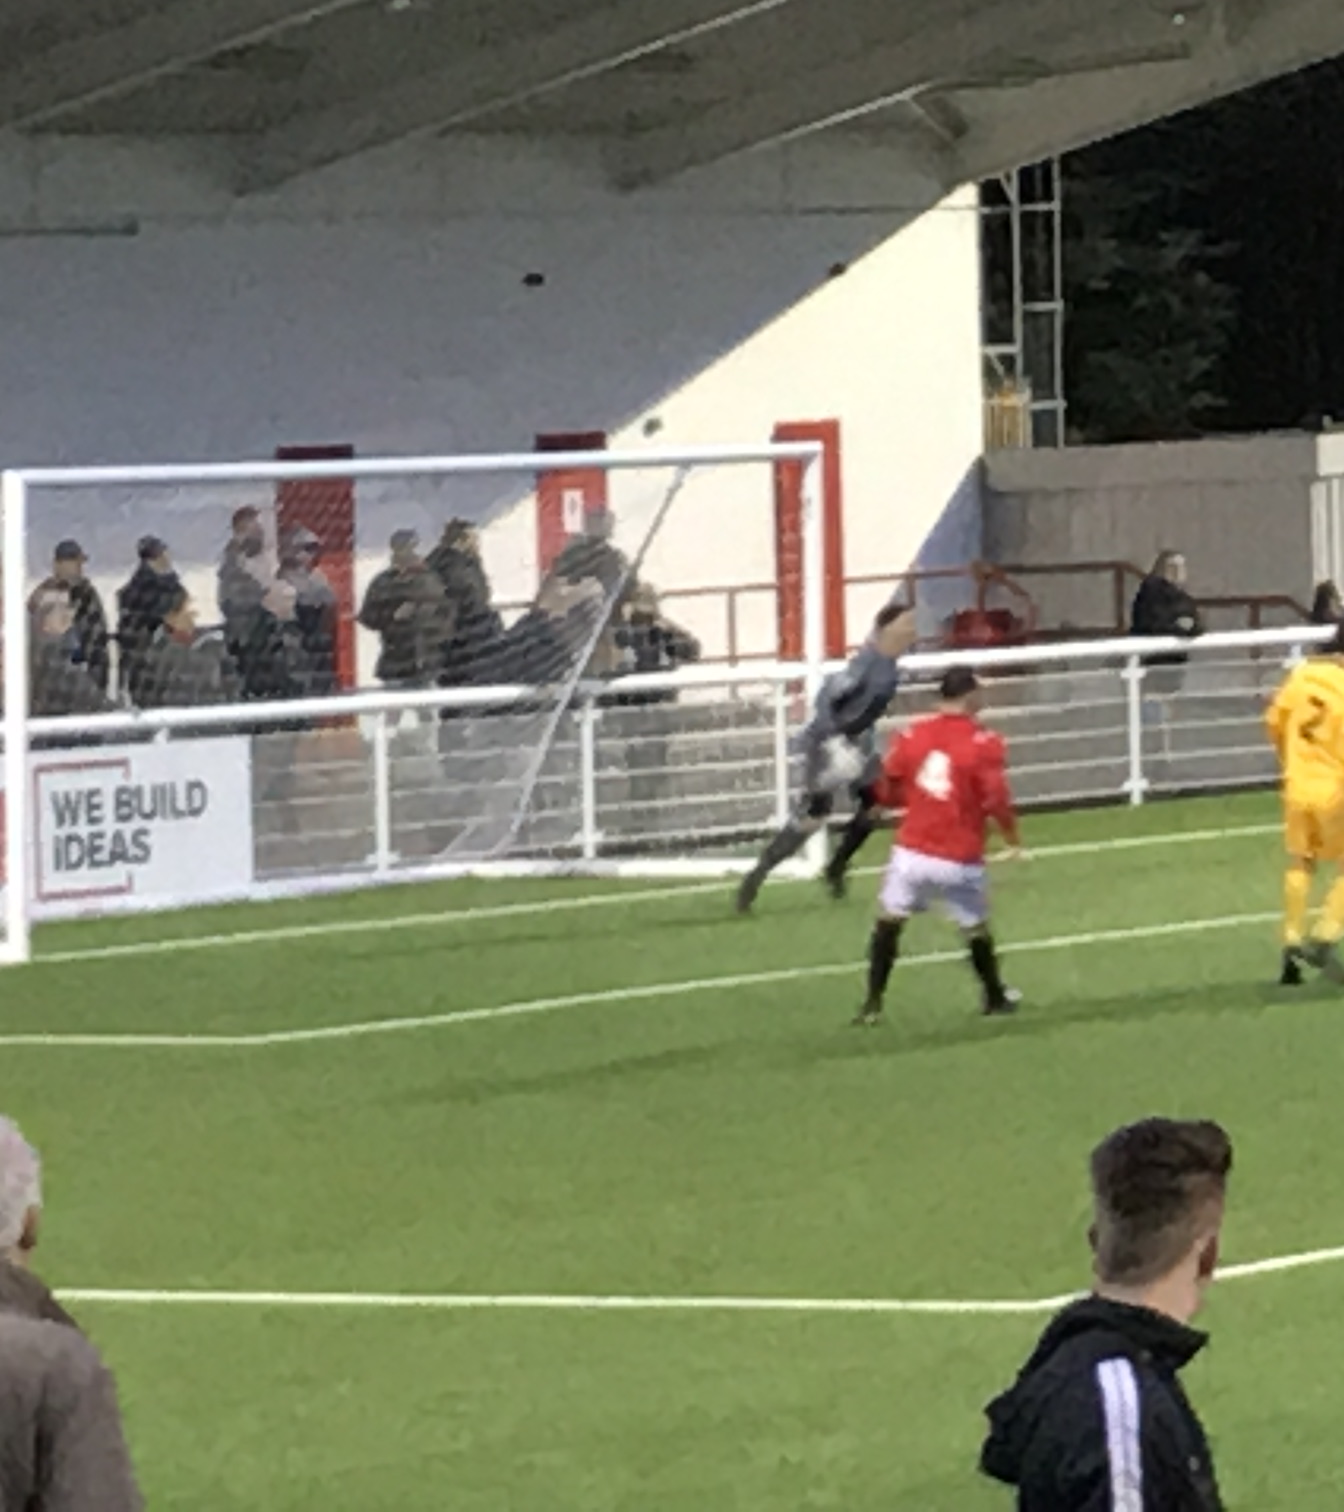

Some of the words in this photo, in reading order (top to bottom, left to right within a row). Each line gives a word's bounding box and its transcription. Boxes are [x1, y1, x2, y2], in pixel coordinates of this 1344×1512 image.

[1298, 694, 1330, 745] 2
[915, 749, 954, 801] 4
[51, 788, 104, 828] WE
[114, 779, 208, 822] BUILD
[53, 828, 152, 872] IDEAS
